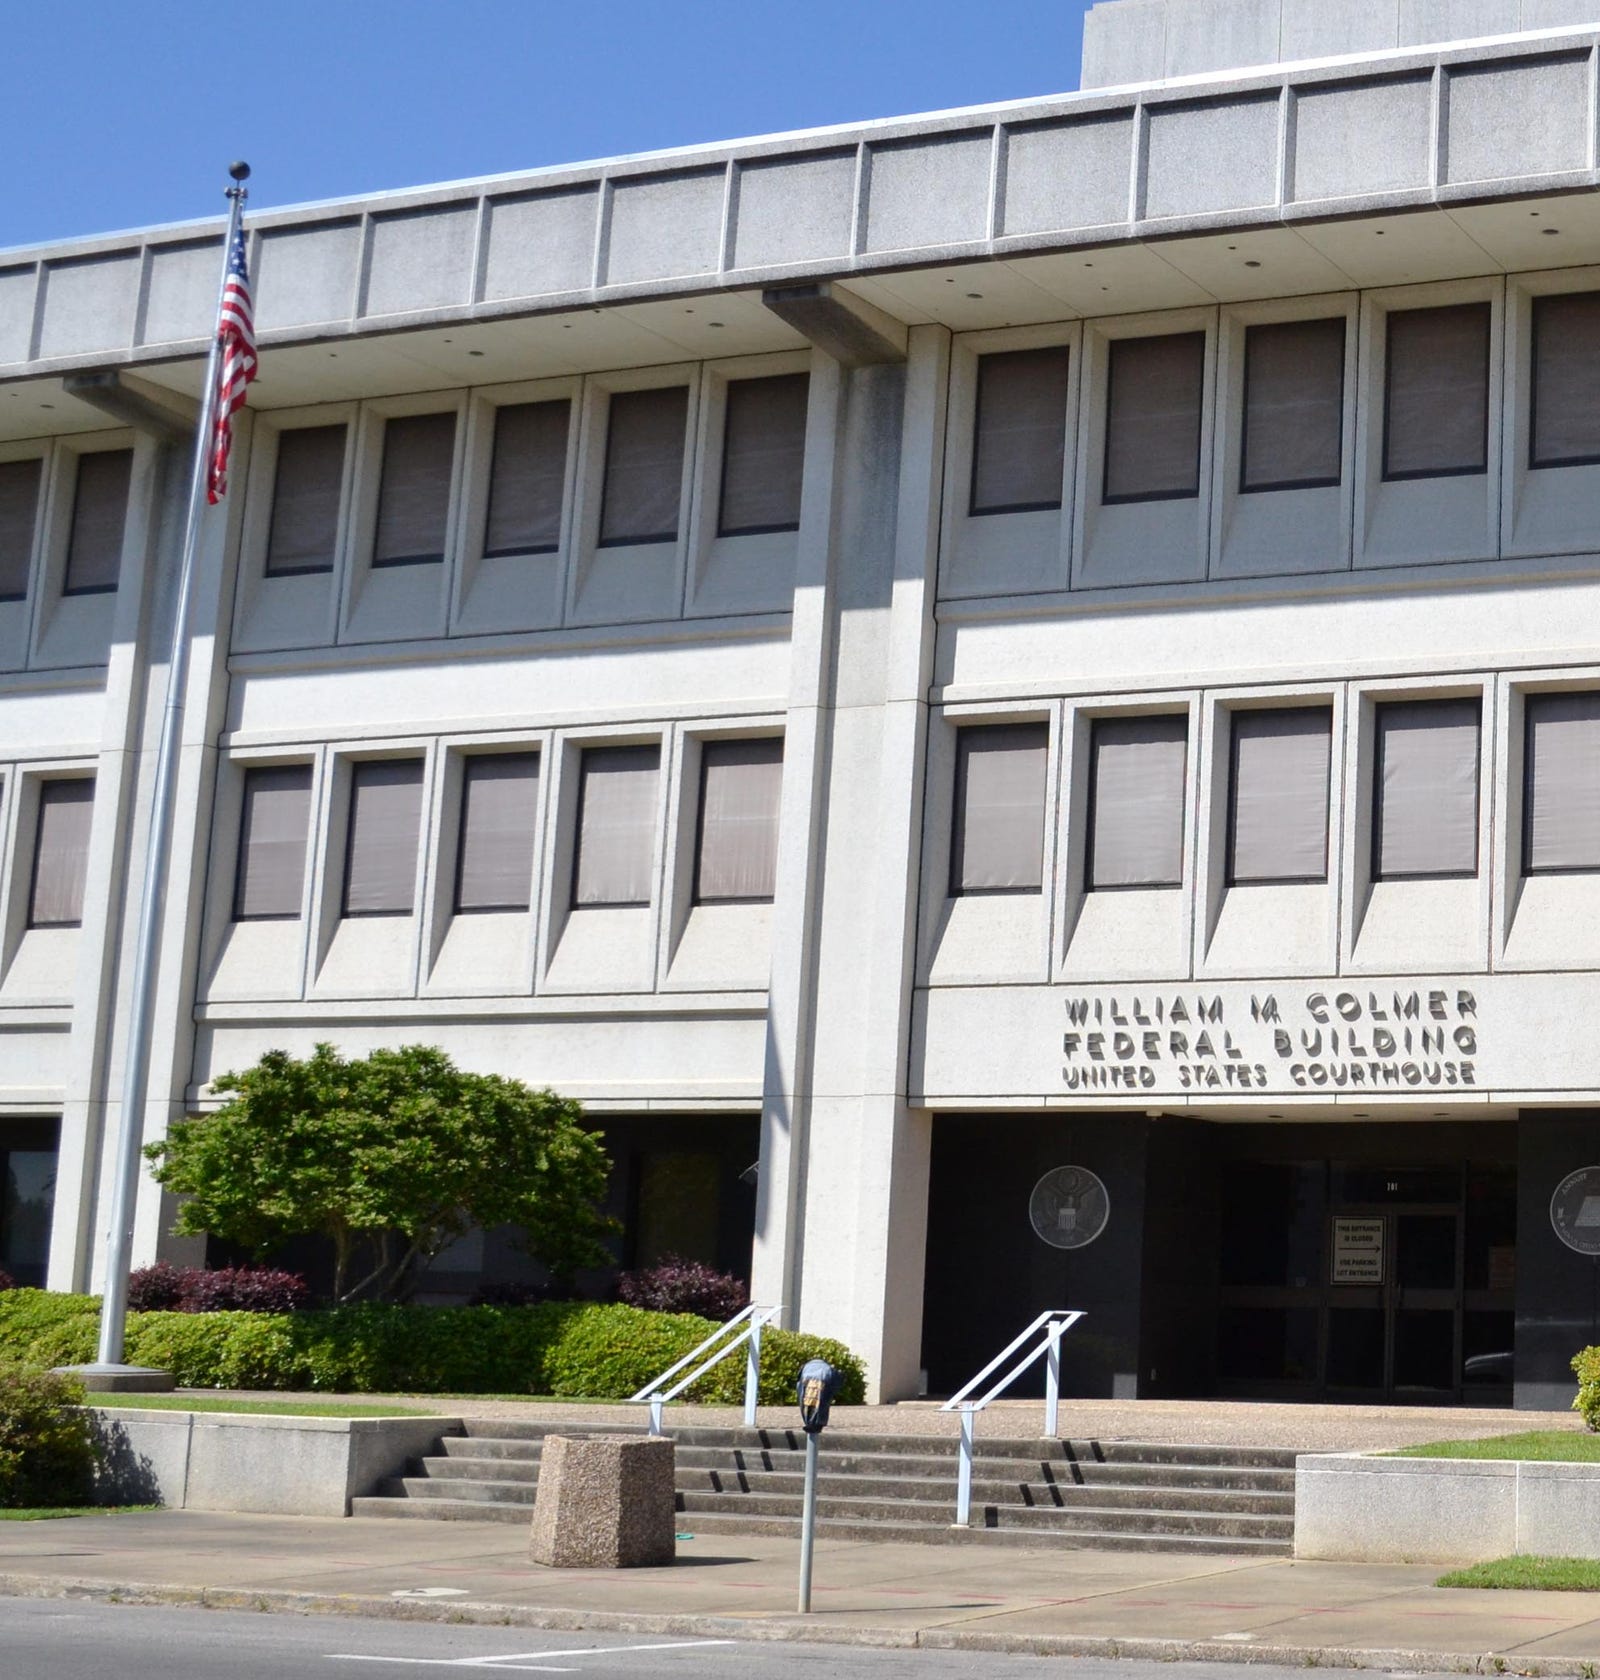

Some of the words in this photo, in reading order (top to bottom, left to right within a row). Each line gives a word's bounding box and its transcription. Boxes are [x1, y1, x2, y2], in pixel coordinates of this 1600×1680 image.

[1065, 995, 1224, 1027] WILLIAM
[1305, 990, 1479, 1023] COLMER
[1063, 1029, 1243, 1061] FEDERAL
[1273, 1024, 1478, 1058] BUILDING
[1062, 1064, 1156, 1089] UNITED
[1177, 1063, 1268, 1088] STATES
[1289, 1060, 1477, 1086] COURTHOUSE
